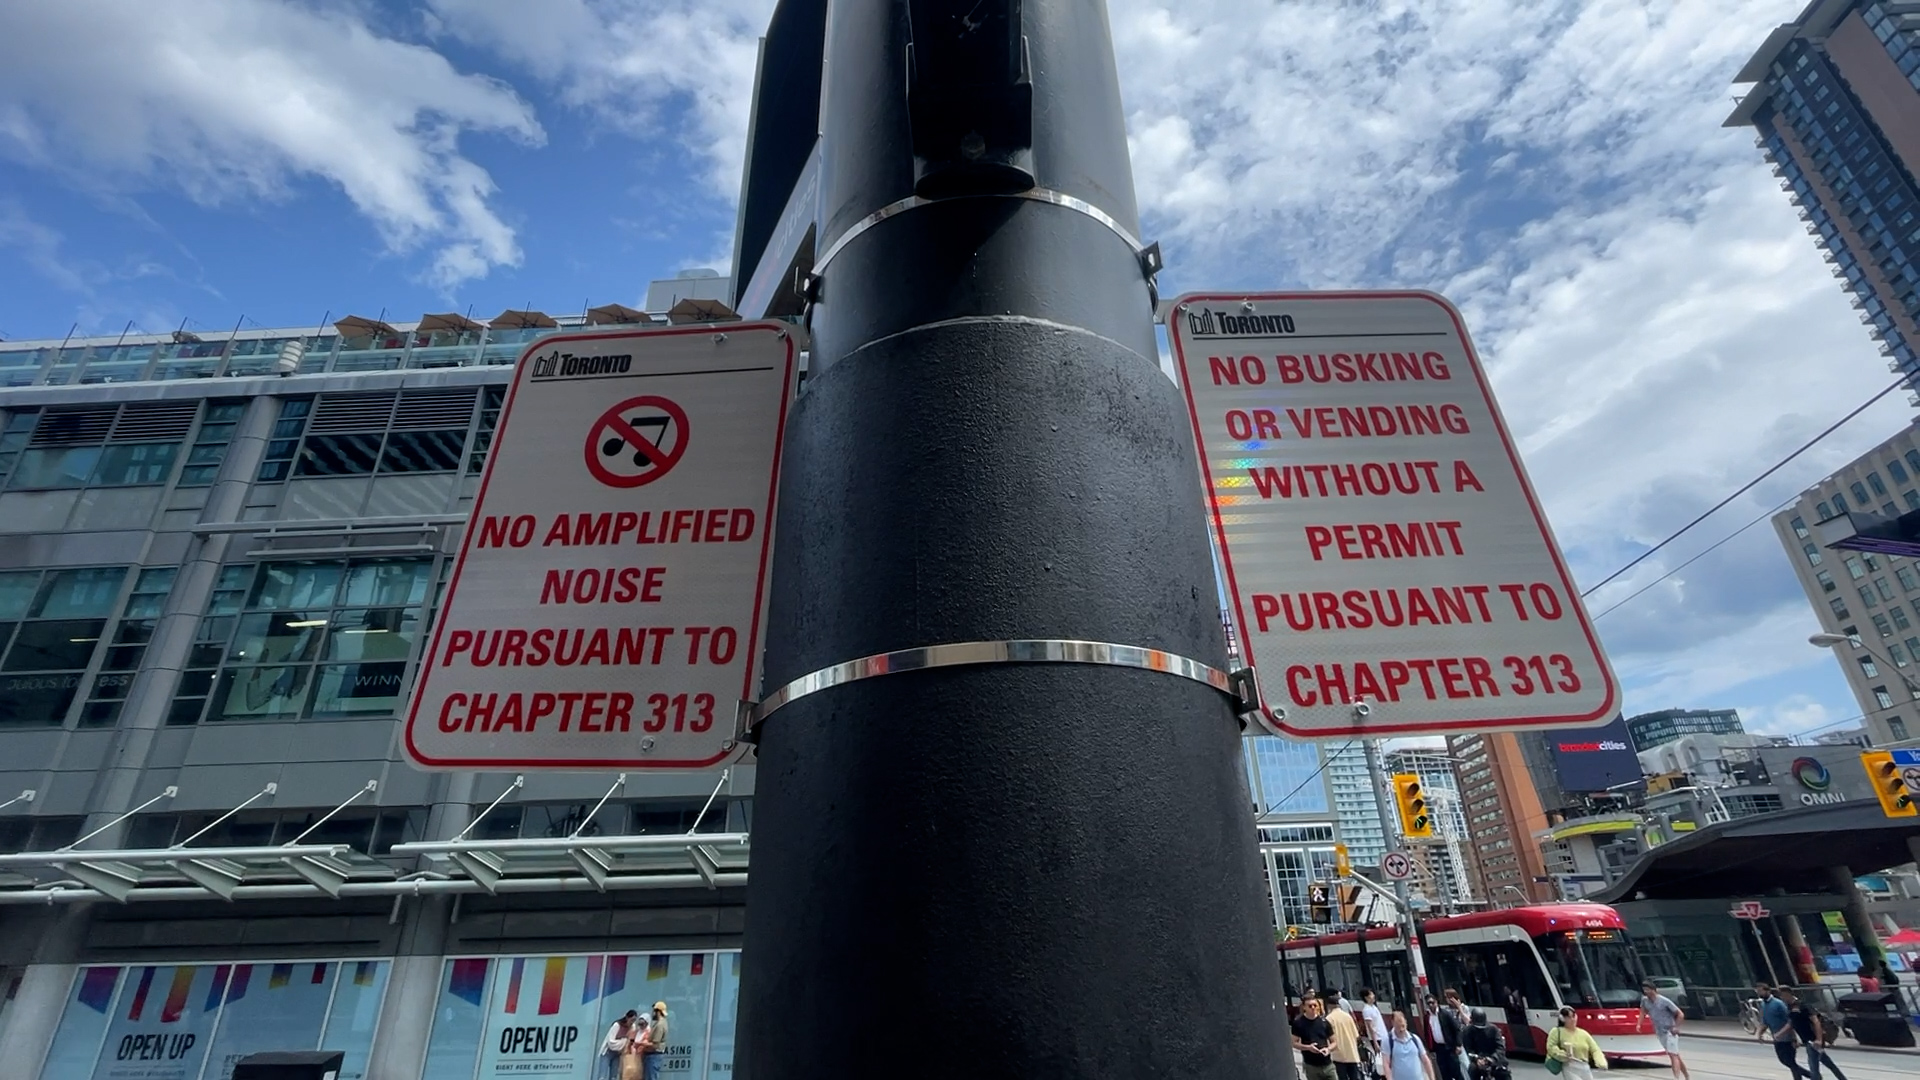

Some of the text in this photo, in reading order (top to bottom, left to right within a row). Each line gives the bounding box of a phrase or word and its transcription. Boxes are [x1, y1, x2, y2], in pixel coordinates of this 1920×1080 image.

[1214, 311, 1295, 334] TORONTO
[560, 353, 632, 376] TORONTO
[1209, 351, 1451, 386] NO BUSKING
[1225, 404, 1470, 441] OR VENDING
[1249, 460, 1485, 500] WITHOUT A
[477, 508, 755, 549] NO AMPLIFIED
[1305, 520, 1464, 561] PERMIT
[540, 567, 666, 605] NOISE
[1251, 582, 1563, 633] PURSUANT TO
[442, 626, 737, 667] PURSUANT TO
[1285, 653, 1582, 708] CHAPTER 313
[437, 692, 715, 733] CHAPTER 313
[1800, 792, 1846, 806] OMNI
[116, 1033, 196, 1060] OPEN UP
[499, 1025, 578, 1054] OPEN UP
